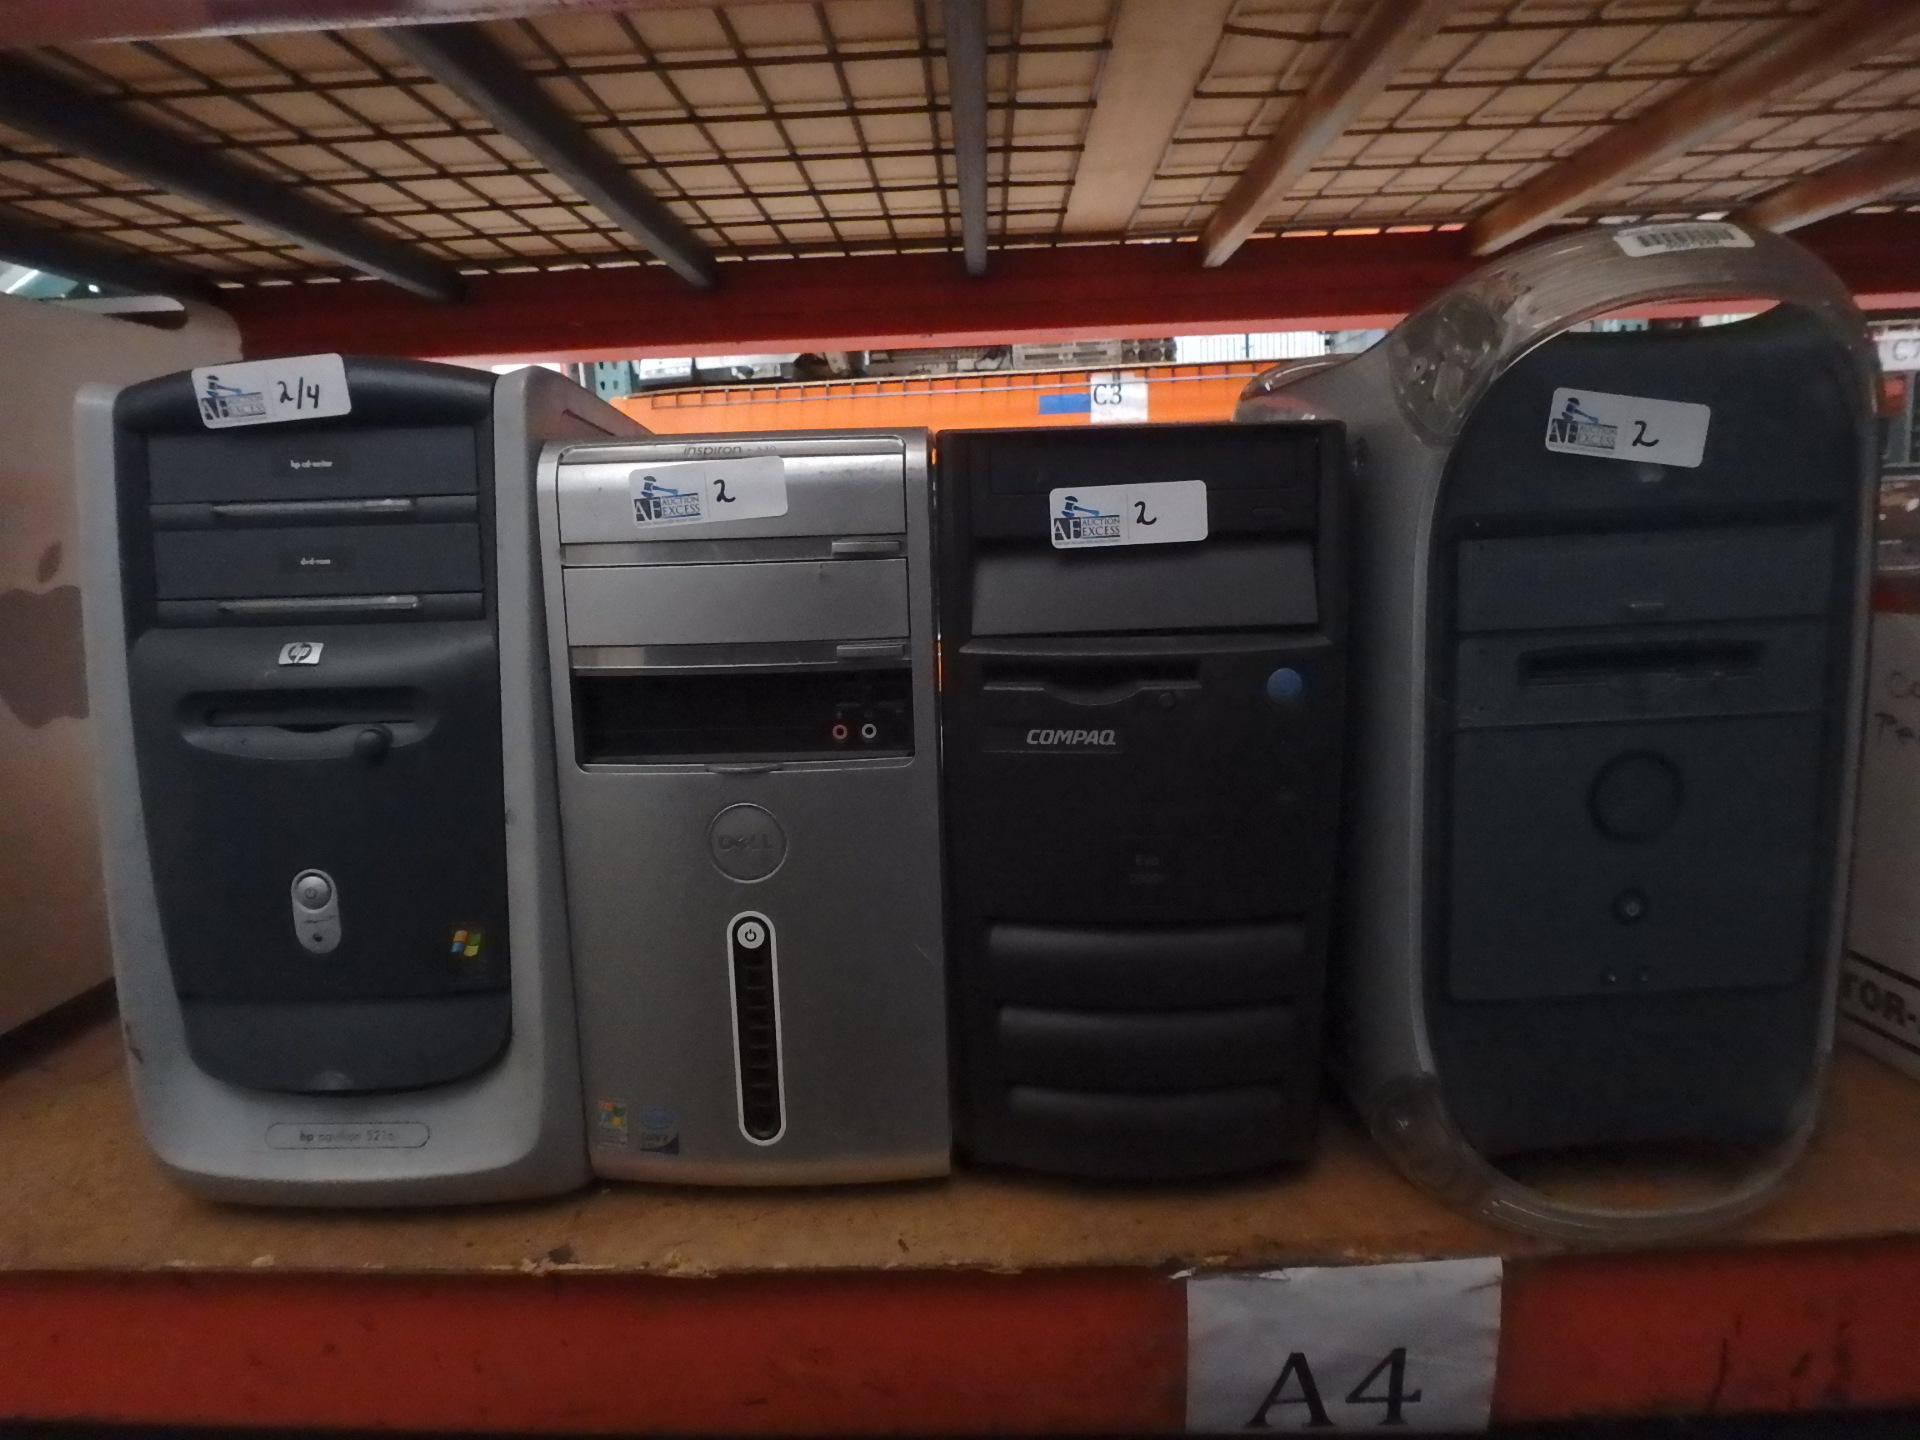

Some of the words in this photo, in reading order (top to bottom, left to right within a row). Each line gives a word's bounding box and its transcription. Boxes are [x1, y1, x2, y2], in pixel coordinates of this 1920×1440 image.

[277, 376, 320, 410] 2/4
[1093, 382, 1123, 406] C3
[1631, 419, 1660, 447] 2
[683, 444, 742, 458] inspiron
[713, 478, 736, 503] 2
[662, 496, 700, 506] AUCTION
[662, 503, 701, 517] EXCESS
[1082, 517, 1121, 527] AUCTION
[1134, 500, 1158, 526] 2
[1082, 525, 1121, 537] EXCESS
[1026, 729, 1117, 746] COMPAQ
[1243, 1347, 1422, 1428] A4
